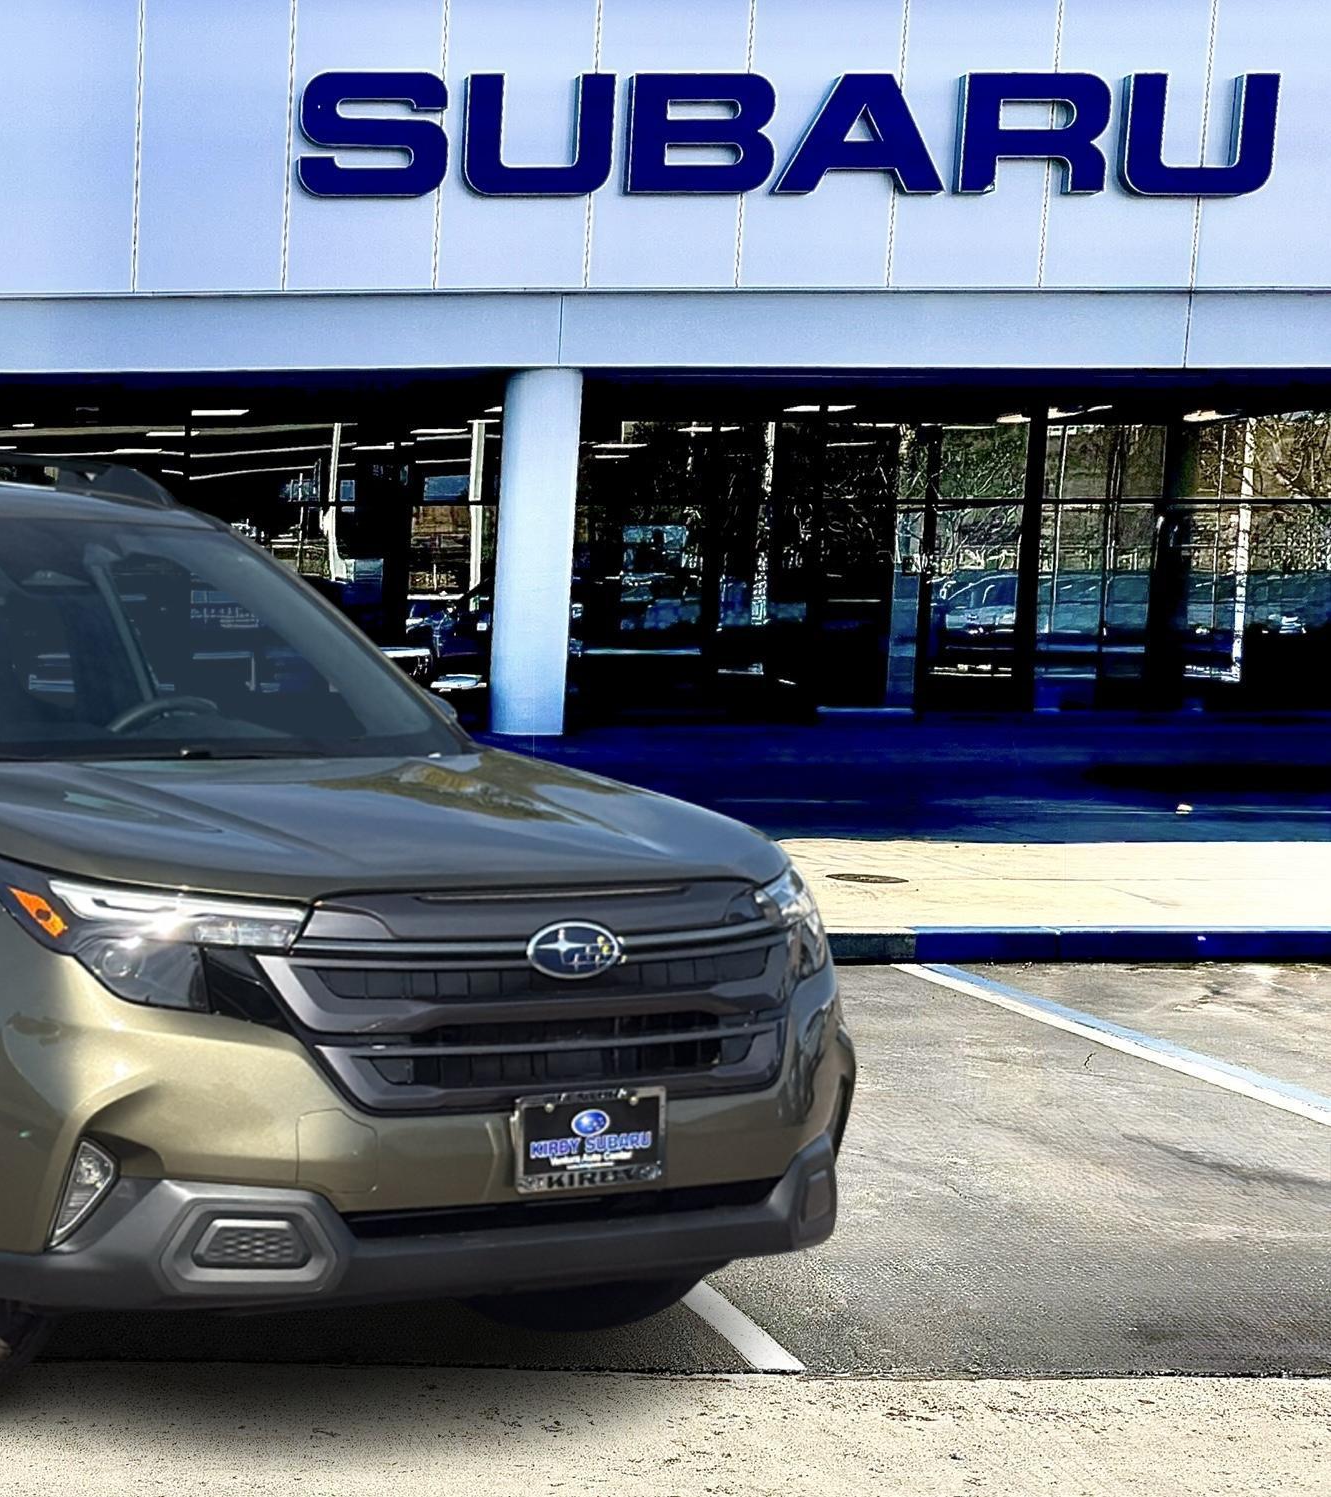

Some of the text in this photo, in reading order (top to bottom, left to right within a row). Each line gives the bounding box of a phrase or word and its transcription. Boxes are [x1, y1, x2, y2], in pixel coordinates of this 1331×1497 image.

[296, 70, 1282, 197] SUBARU
[530, 1131, 652, 1159] KIRBY SUBARU
[547, 1169, 637, 1189] KIRBY
